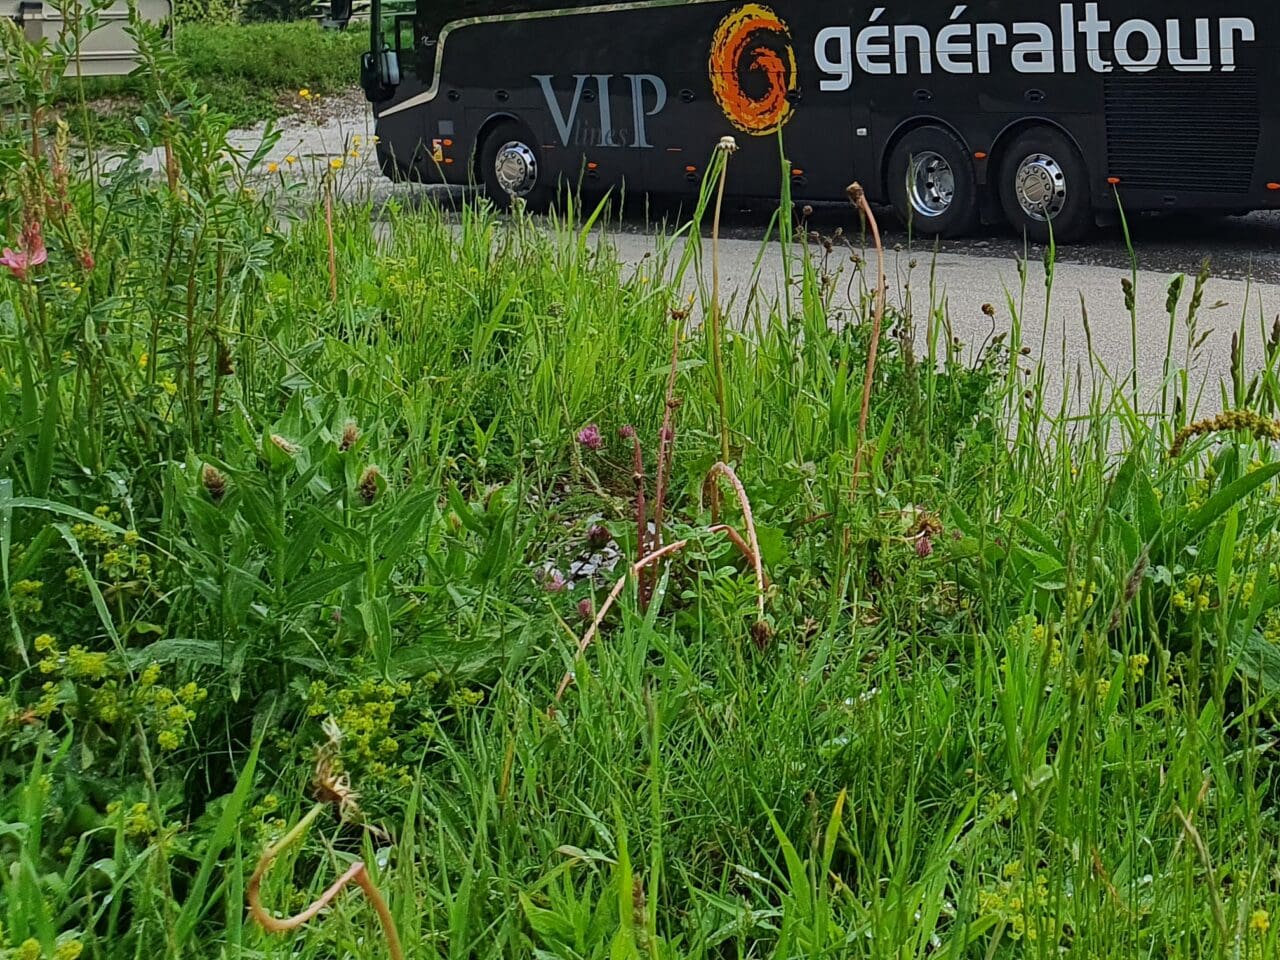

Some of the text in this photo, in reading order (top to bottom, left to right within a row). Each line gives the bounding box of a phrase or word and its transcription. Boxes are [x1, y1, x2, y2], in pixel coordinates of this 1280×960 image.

[814, 1, 1256, 92] généraltour
[530, 74, 668, 148] VIP
[574, 119, 628, 146] lines
